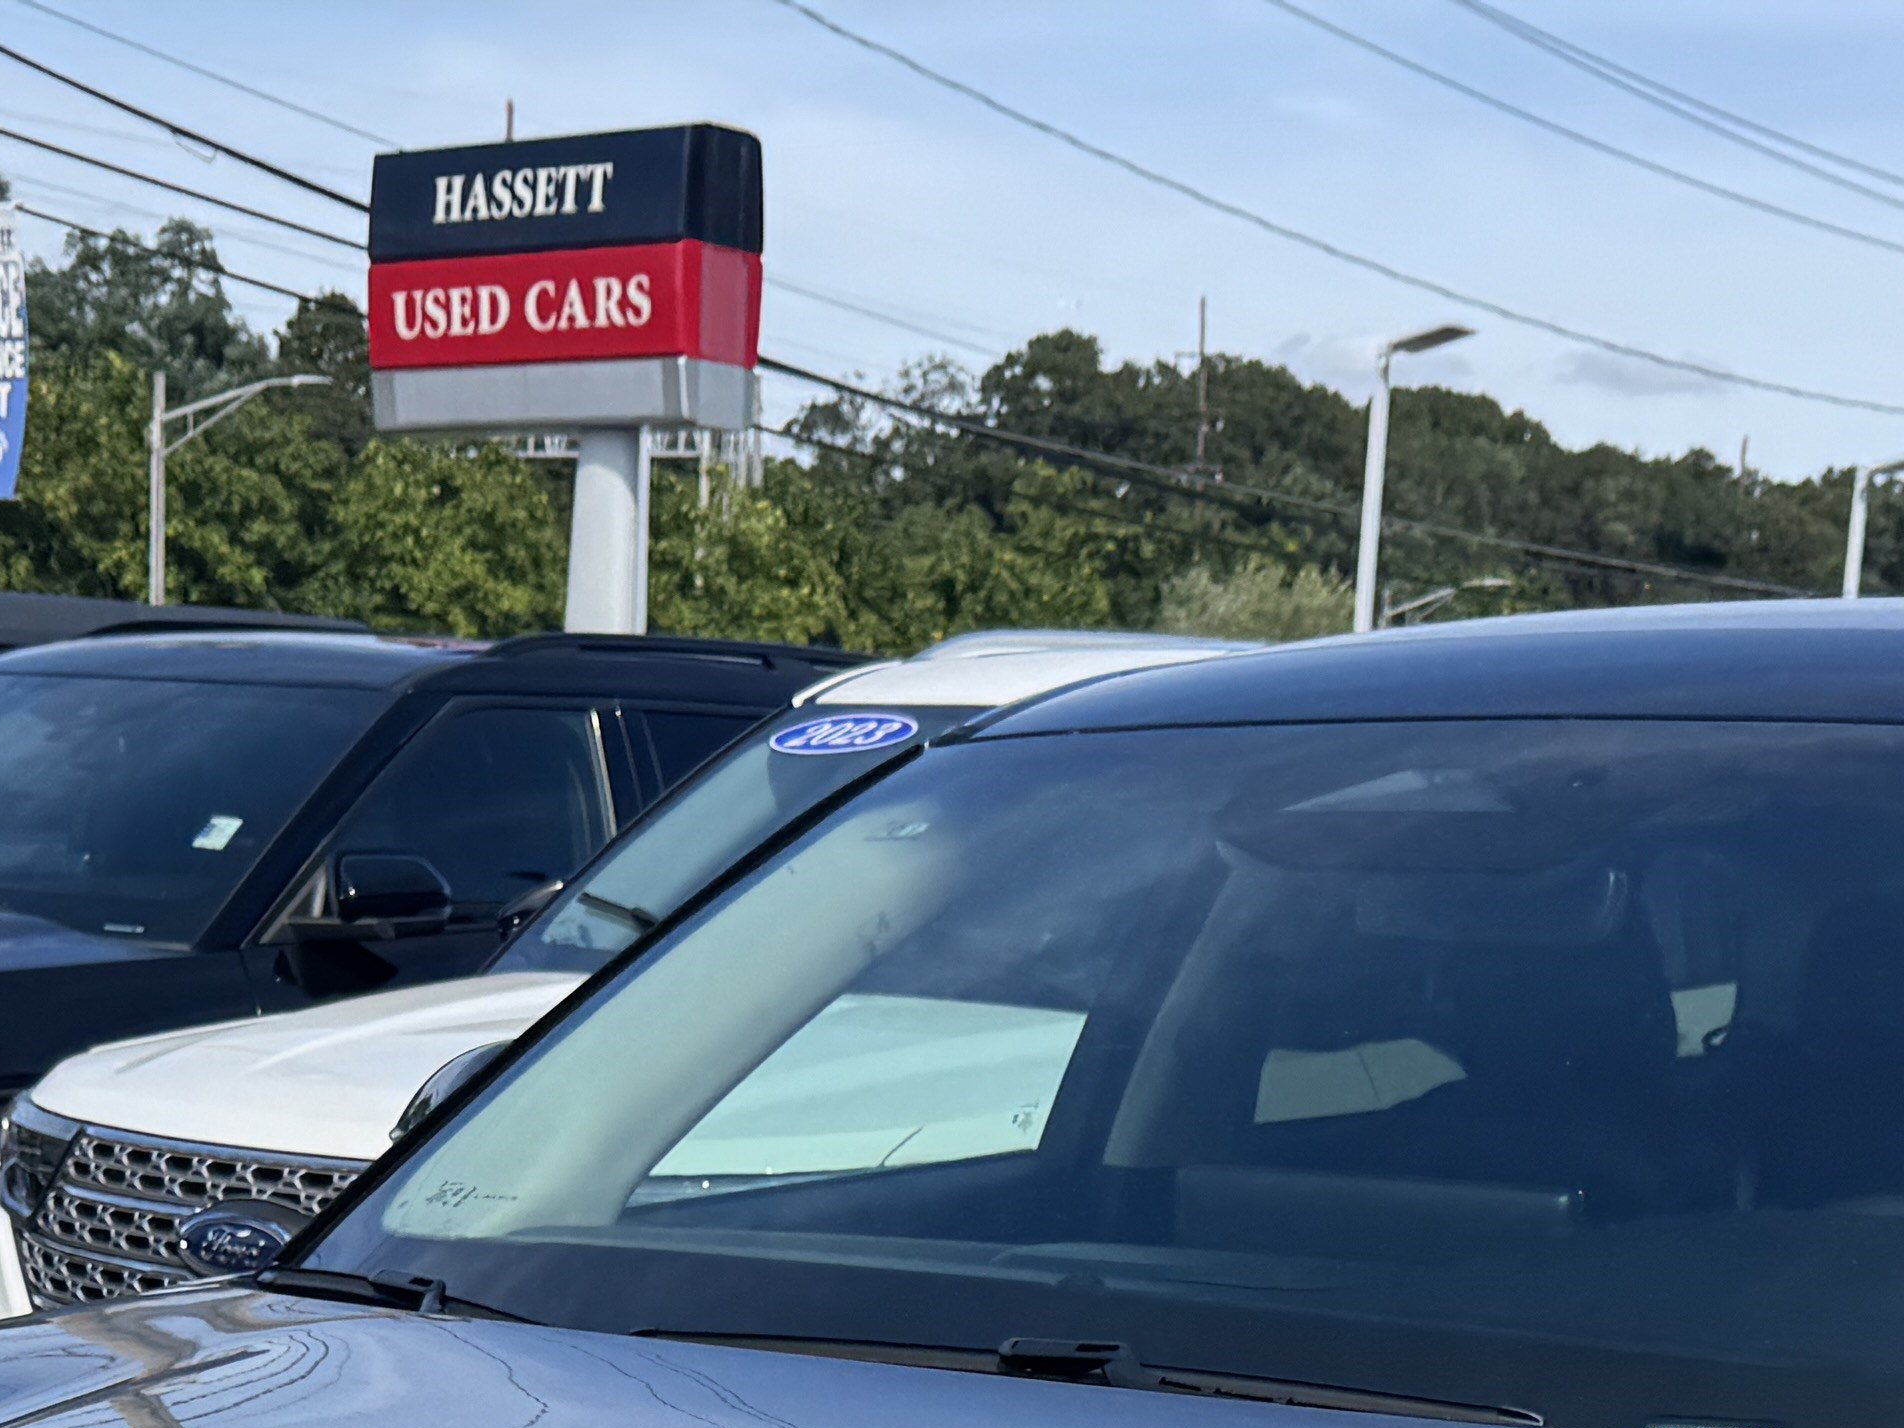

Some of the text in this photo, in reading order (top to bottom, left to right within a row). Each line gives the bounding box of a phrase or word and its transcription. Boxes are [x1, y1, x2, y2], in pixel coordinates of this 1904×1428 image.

[432, 162, 614, 224] HASSETT
[392, 273, 652, 341] USED CARS
[782, 719, 904, 748] 2023
